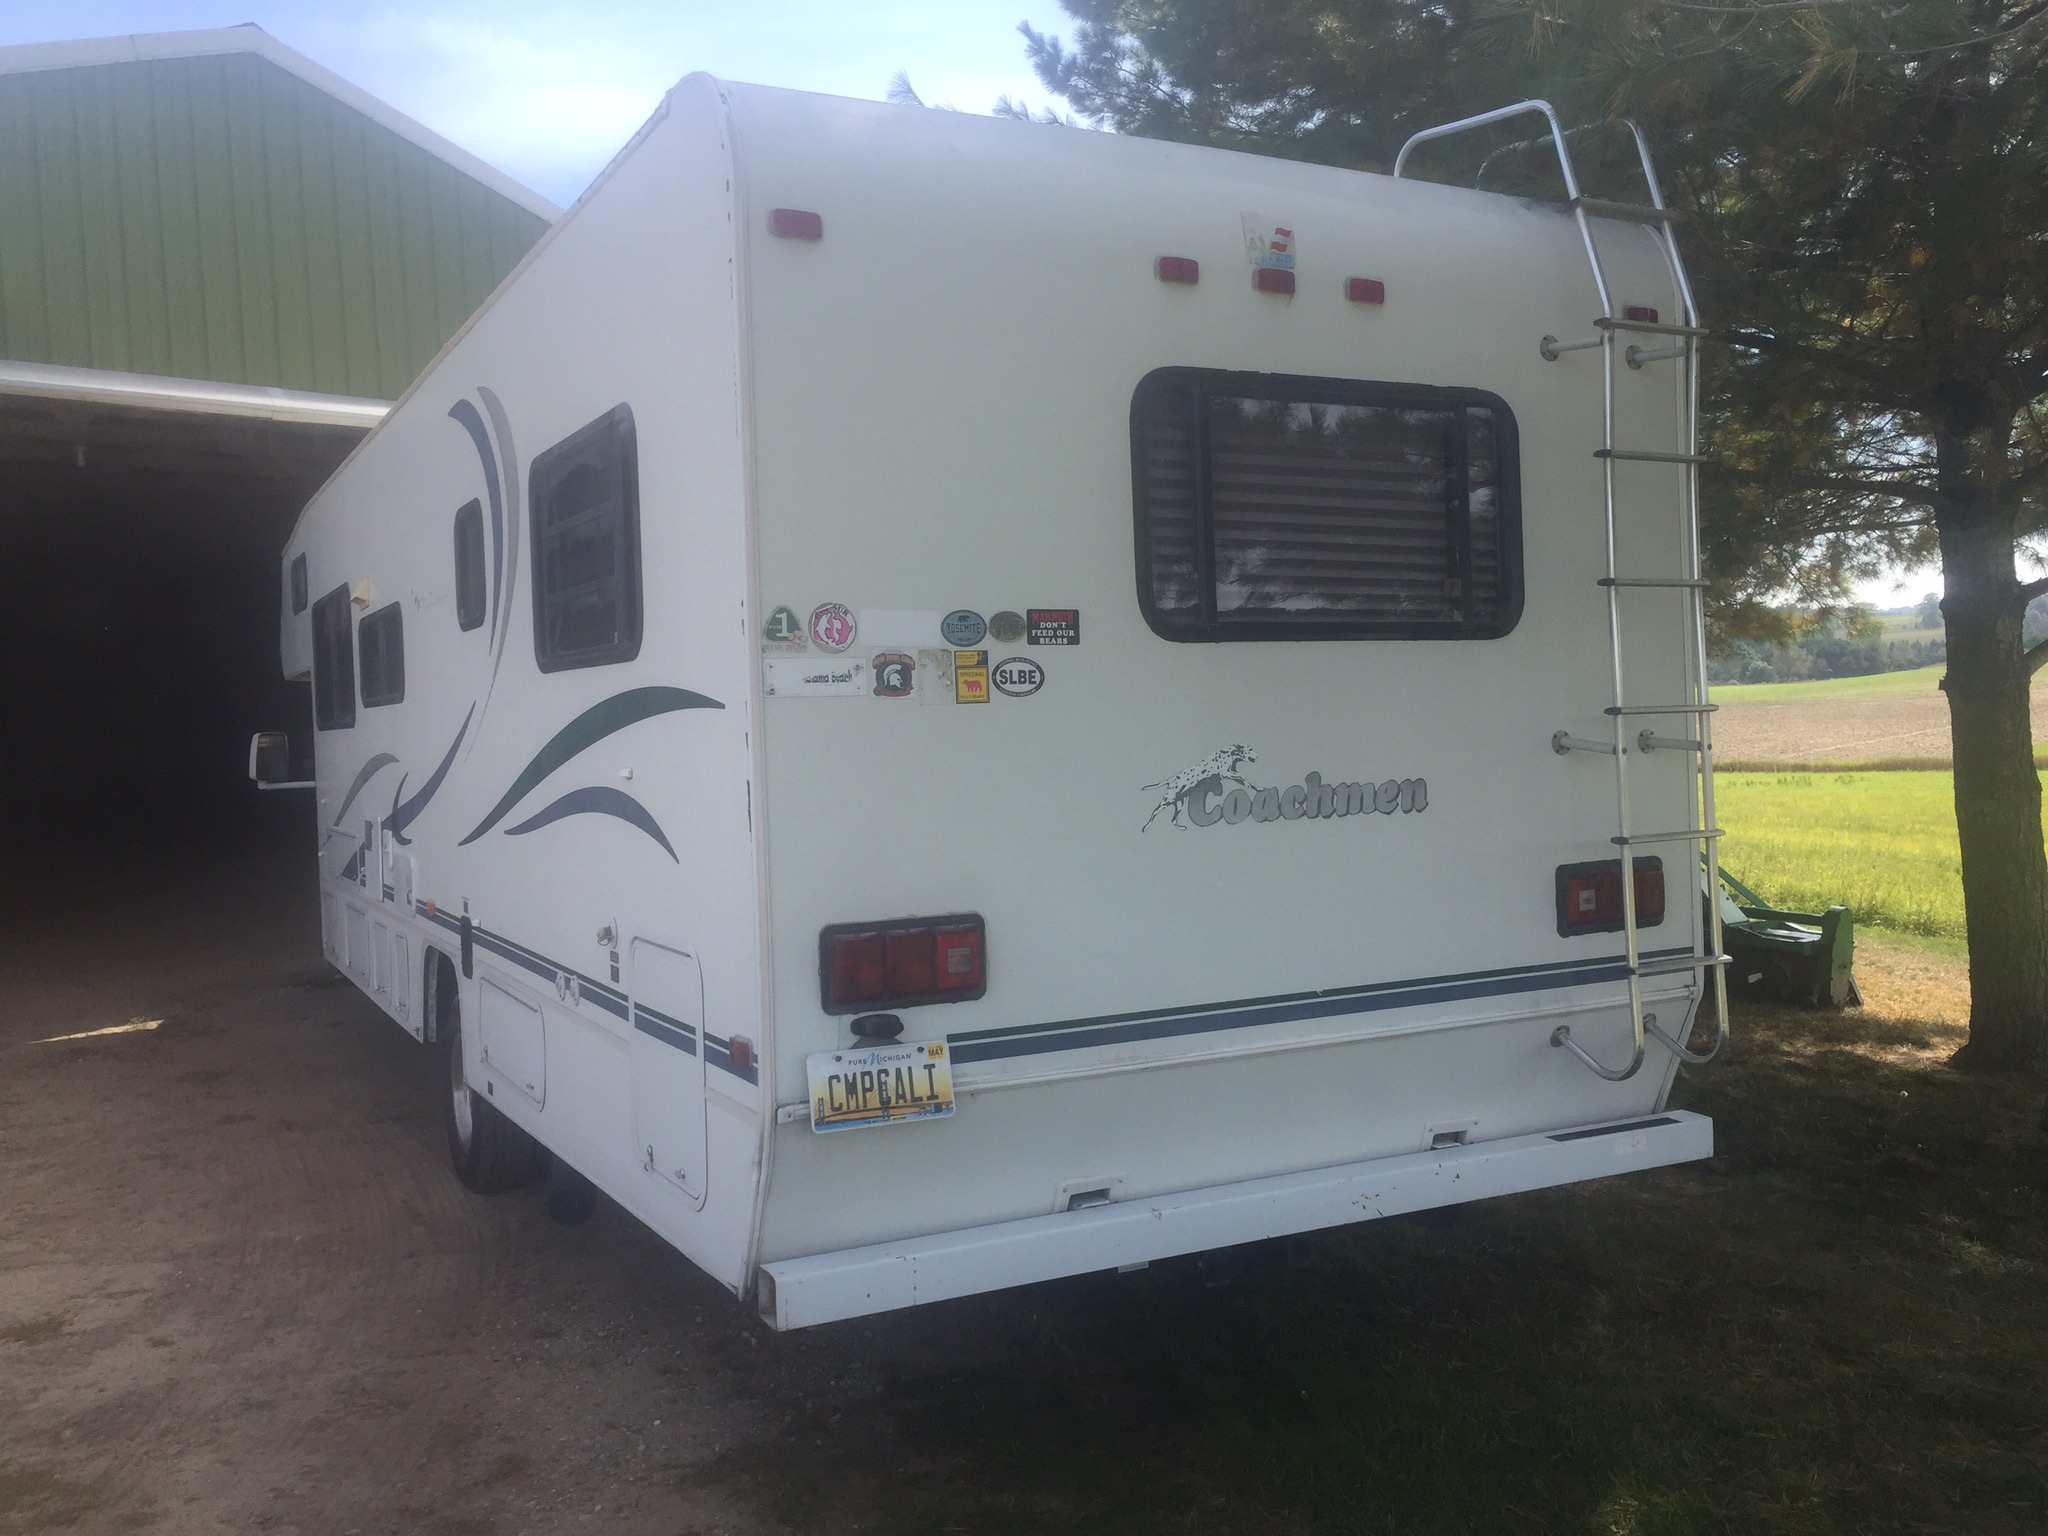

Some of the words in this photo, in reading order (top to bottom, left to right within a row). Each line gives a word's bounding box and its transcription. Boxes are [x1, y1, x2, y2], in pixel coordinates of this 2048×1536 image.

[832, 603, 849, 617] SUR
[775, 612, 790, 637] 1
[946, 622, 980, 634] YOSEMITE
[1040, 621, 1067, 629] DON'T
[1031, 629, 1054, 637] FEED
[1056, 629, 1075, 637] OUR
[1039, 637, 1068, 645] BEARS
[998, 669, 1037, 686] SLBE
[1186, 771, 1429, 828] Coachmen
[928, 1047, 944, 1057] MAY
[848, 1058, 868, 1066] PURE
[863, 1052, 912, 1069] MICHIGAN
